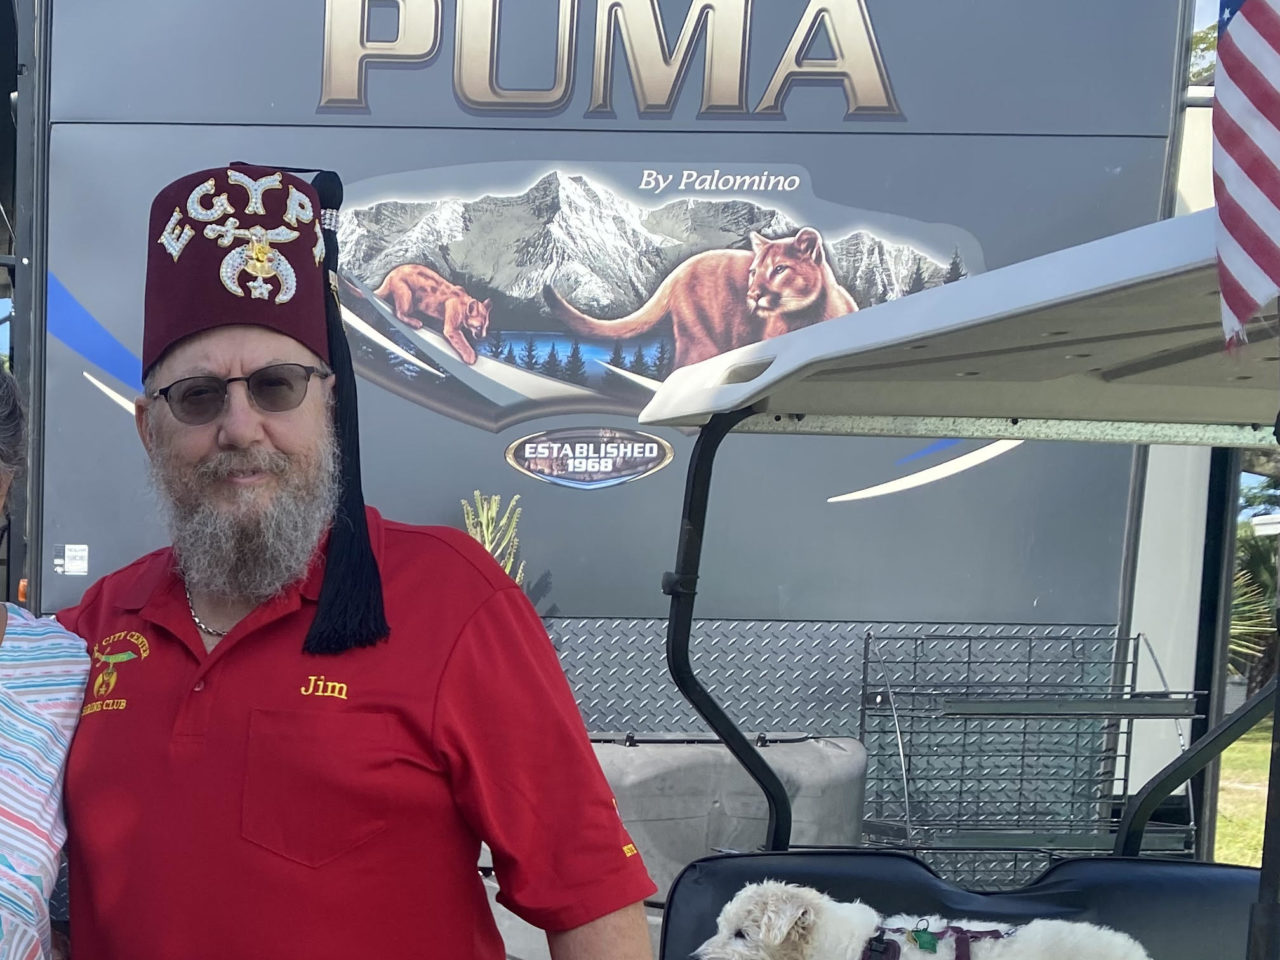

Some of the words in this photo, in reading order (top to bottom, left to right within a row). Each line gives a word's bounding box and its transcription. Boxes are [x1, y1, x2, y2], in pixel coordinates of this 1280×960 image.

[316, 0, 905, 118] PUMA
[639, 169, 673, 194] By
[678, 169, 801, 192] Palomino
[524, 443, 658, 458] ESTABLISHED
[567, 458, 613, 472] 1968
[102, 630, 128, 646] CITY
[300, 675, 348, 700] Jim
[103, 699, 127, 710] CLUB
